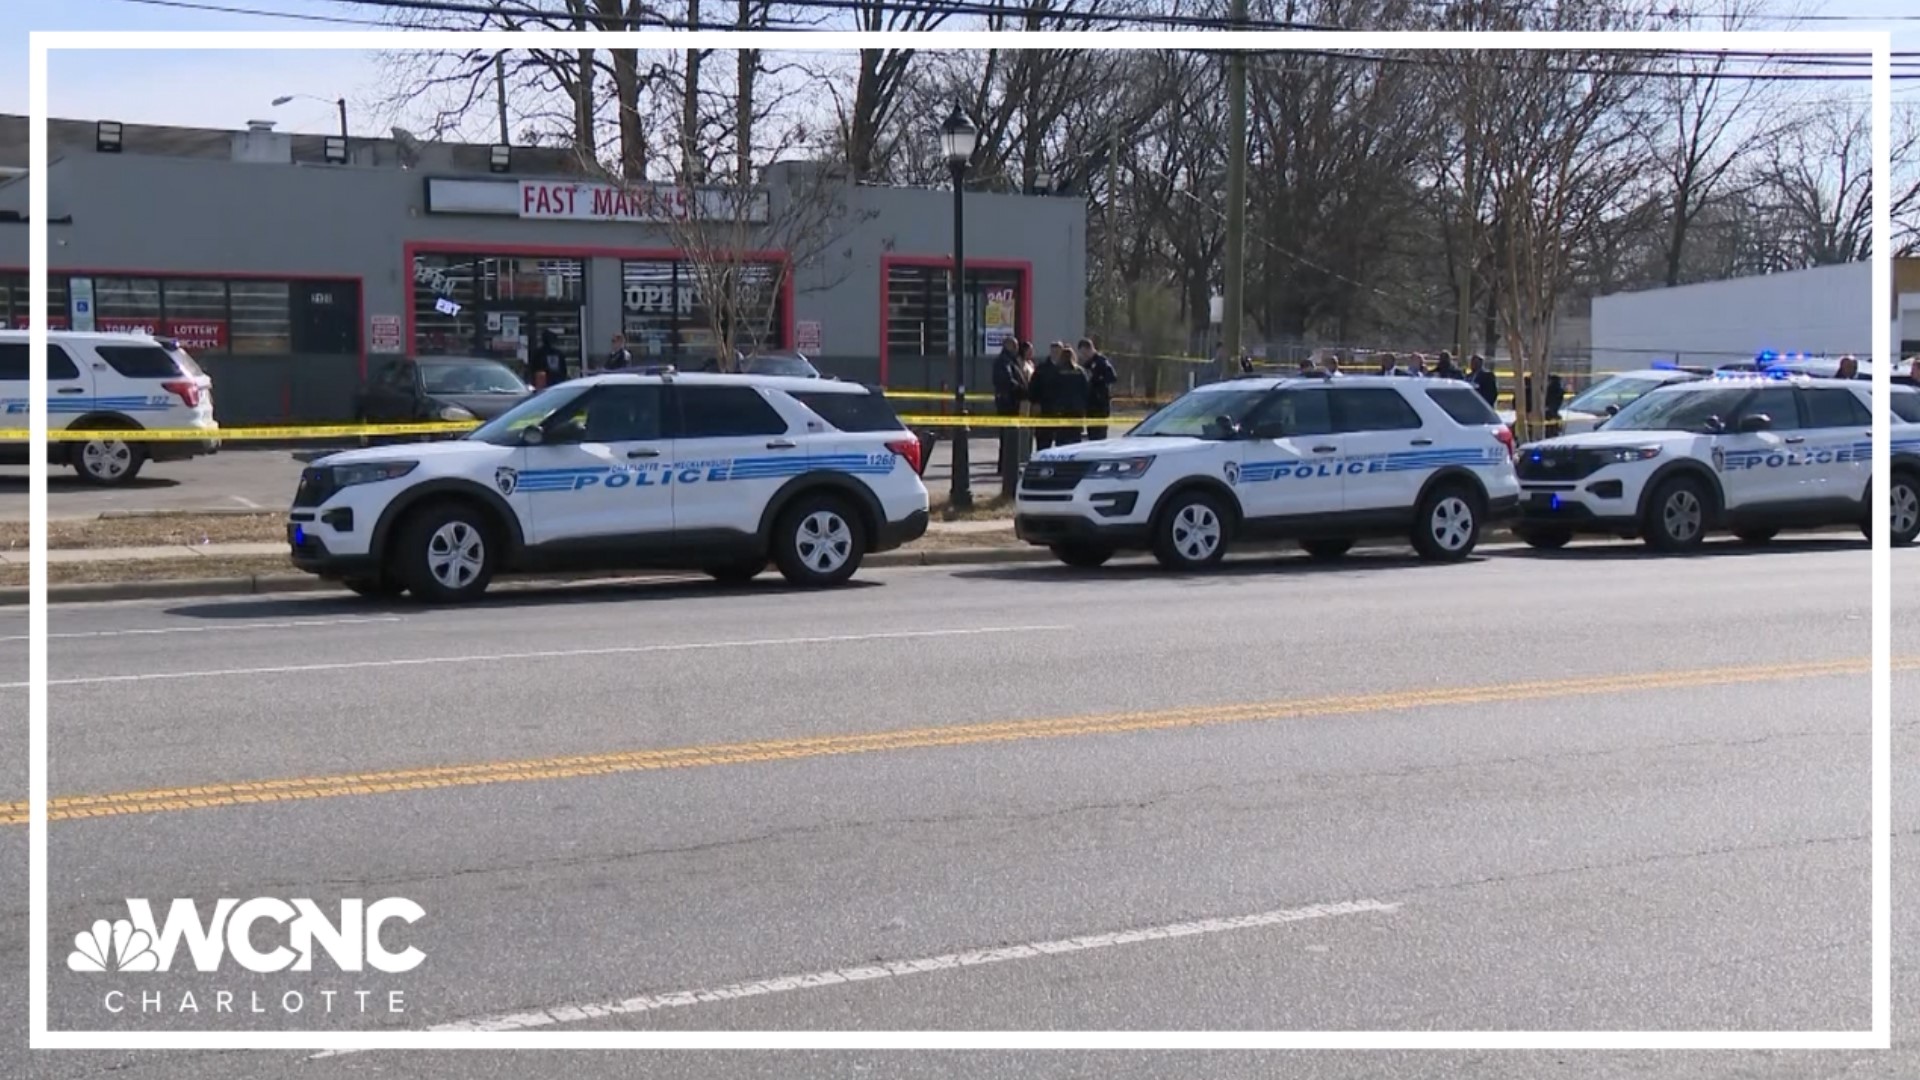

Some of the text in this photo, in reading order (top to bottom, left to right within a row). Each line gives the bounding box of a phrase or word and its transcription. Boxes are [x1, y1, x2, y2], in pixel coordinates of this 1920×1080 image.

[524, 186, 576, 213] FAST
[593, 188, 655, 217] MAR
[625, 286, 693, 313] OPEN
[174, 325, 218, 335] LOTTERY
[1273, 460, 1386, 480] POLICE
[1745, 450, 1851, 470] POLICE
[574, 468, 730, 490] POLICE
